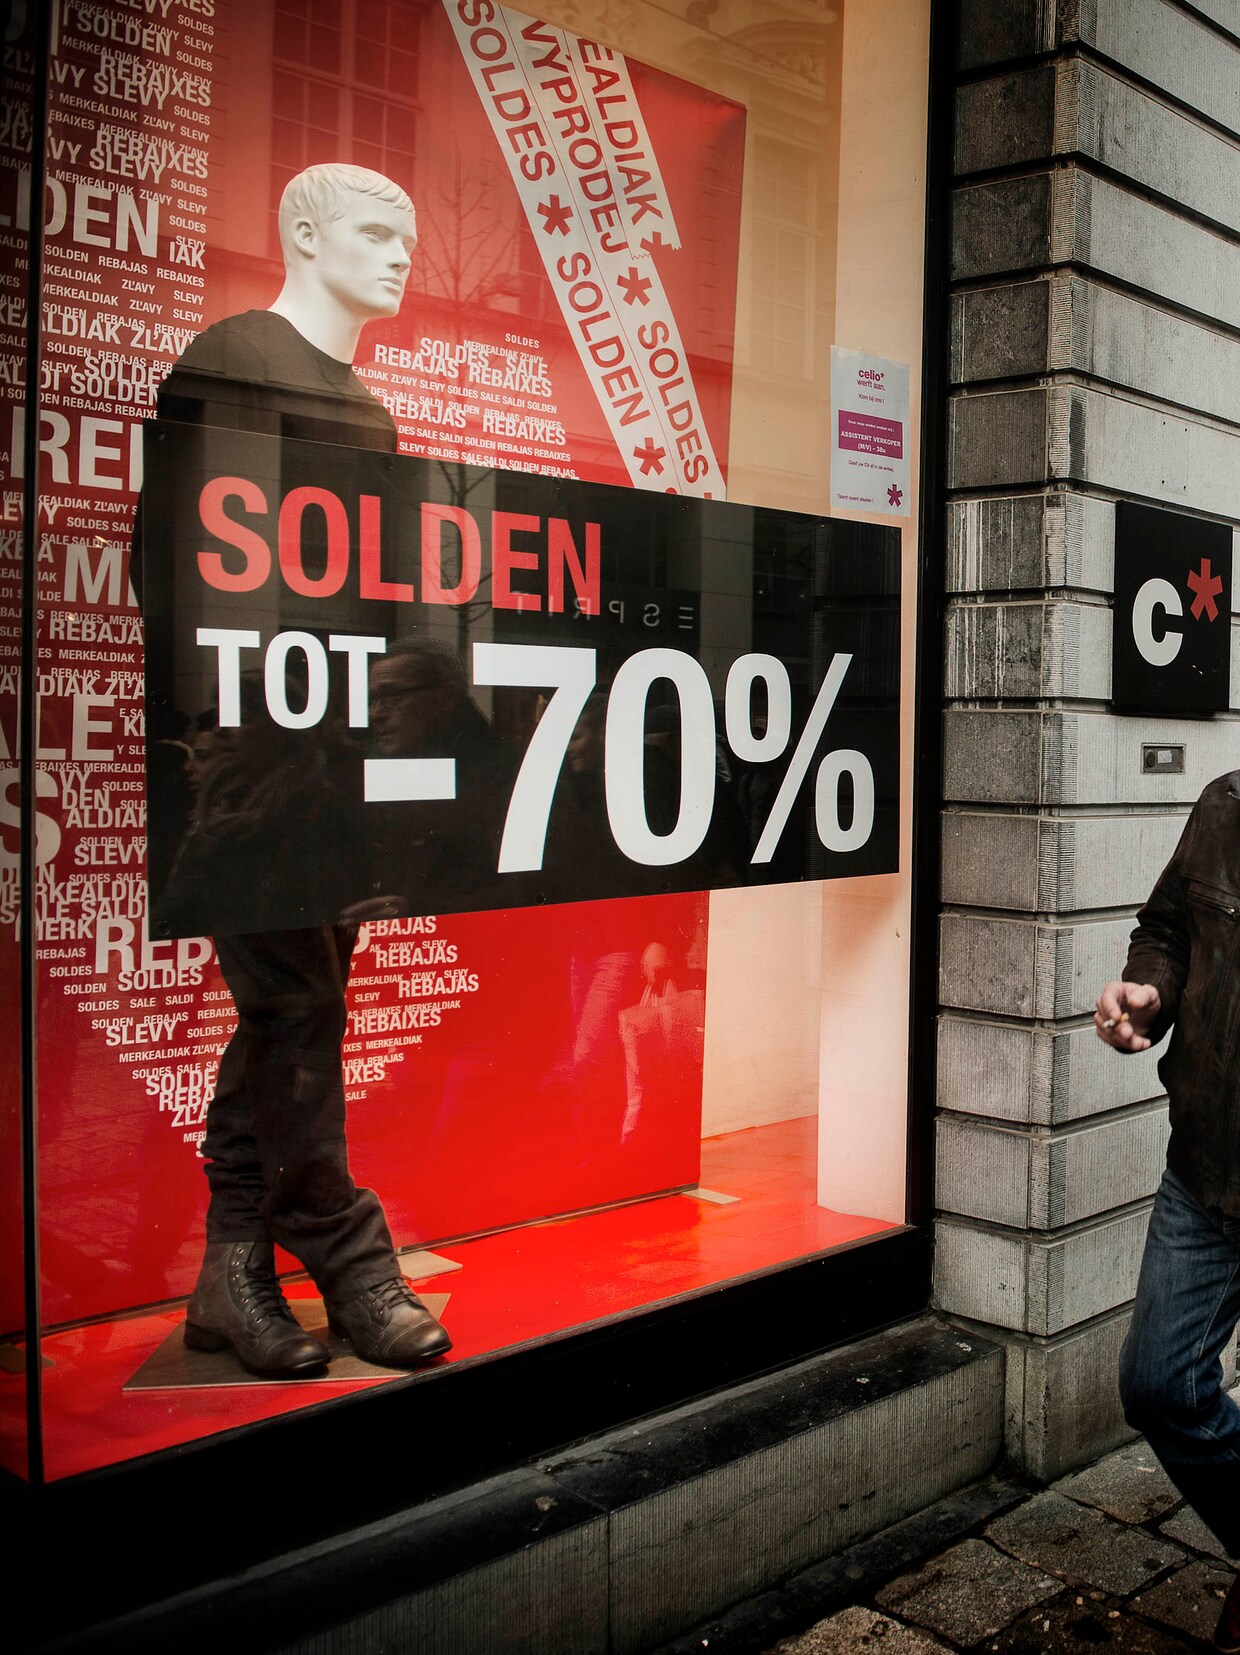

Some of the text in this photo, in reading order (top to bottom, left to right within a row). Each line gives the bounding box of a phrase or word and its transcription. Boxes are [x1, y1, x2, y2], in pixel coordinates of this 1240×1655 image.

[77, 9, 170, 57] SOLDEN
[178, 15, 214, 36] SOLDES
[184, 35, 213, 54] SLEVY
[176, 51, 213, 72] SOLDES
[93, 72, 168, 110] SLEVY
[100, 55, 211, 107] REBAIXES
[60, 93, 210, 144] MERKEALDIAK SLEVY
[174, 105, 210, 126] SOLDES
[96, 130, 208, 179] REBAIXES
[89, 149, 165, 185] SLEVY
[56, 169, 207, 215] MERKEALDIAK SLEVY
[170, 178, 208, 197] SOLDES
[169, 215, 207, 233] SOLDES
[458, 0, 651, 428] SOLDES SOLDEN
[45, 244, 205, 288] SOLDEN REBAJAS REBAIXES
[173, 290, 204, 306] SLEVY
[43, 302, 146, 330] SOLDEN REBAJAS
[172, 309, 204, 324] SLEVY
[505, 333, 540, 349] SOLDES
[47, 341, 91, 358] SOLDEN
[98, 350, 147, 368] REBAJAS
[420, 337, 548, 381] SOLDES SALE
[42, 360, 77, 374] SLEVY
[375, 344, 552, 398] REBAJAS REBAIXES
[352, 366, 557, 414] EALDIAK SLEVY SOLDES SALE SALDI SOLDEN
[63, 396, 112, 413] REBAJAS
[393, 391, 562, 429] SALE SALDI SOLDEN REBAJAS REBAIXES
[637, 320, 709, 484] SOLDES
[383, 397, 566, 446] REBAJAS REBAIXES
[416, 428, 571, 462] SALE SALDI SOLDEN REBAJAS REBAIXES
[399, 442, 576, 478] SLEVY SOLDES SALE SALDI SOLDEN REBAJAS
[67, 517, 109, 531] SOLDES
[41, 533, 69, 546] SALE
[197, 476, 601, 617] SOLDEN
[50, 619, 145, 645] REBAJA
[59, 649, 135, 663] MERKEALDIAK
[51, 668, 100, 680] REBAJAS
[196, 628, 387, 729] TOT
[364, 643, 876, 874] -70%
[102, 781, 144, 792] SOLDES
[80, 836, 122, 847] SOLDEN
[74, 845, 147, 866] SLEVY
[69, 873, 142, 884] SOLDES SALE
[36, 947, 86, 960] REBAJAS
[376, 945, 458, 968] REBAJAS
[49, 965, 92, 977] SOLDES
[64, 966, 203, 995] SOLDEN SOLDES
[398, 974, 479, 998] REBAJAS
[78, 990, 234, 1012] SOLDES SALE SALDI SOLDE
[355, 992, 380, 1003] SLEVY
[405, 1000, 461, 1014] MERKEALDIAK
[91, 1007, 239, 1030] SOLDEN REBAJAS REBAIXE
[354, 1009, 441, 1035] REBAIXES
[106, 1021, 177, 1047] SLEVY
[187, 1026, 223, 1038] SOLDES
[366, 1035, 422, 1050] MERKEALDIAK
[119, 1047, 190, 1063] MERKEALDIAK
[367, 1053, 404, 1066] REBAJAS
[132, 1063, 201, 1079] SOLDES SALE
[146, 1069, 217, 1096] SOLDE
[345, 1090, 367, 1102] SALE
